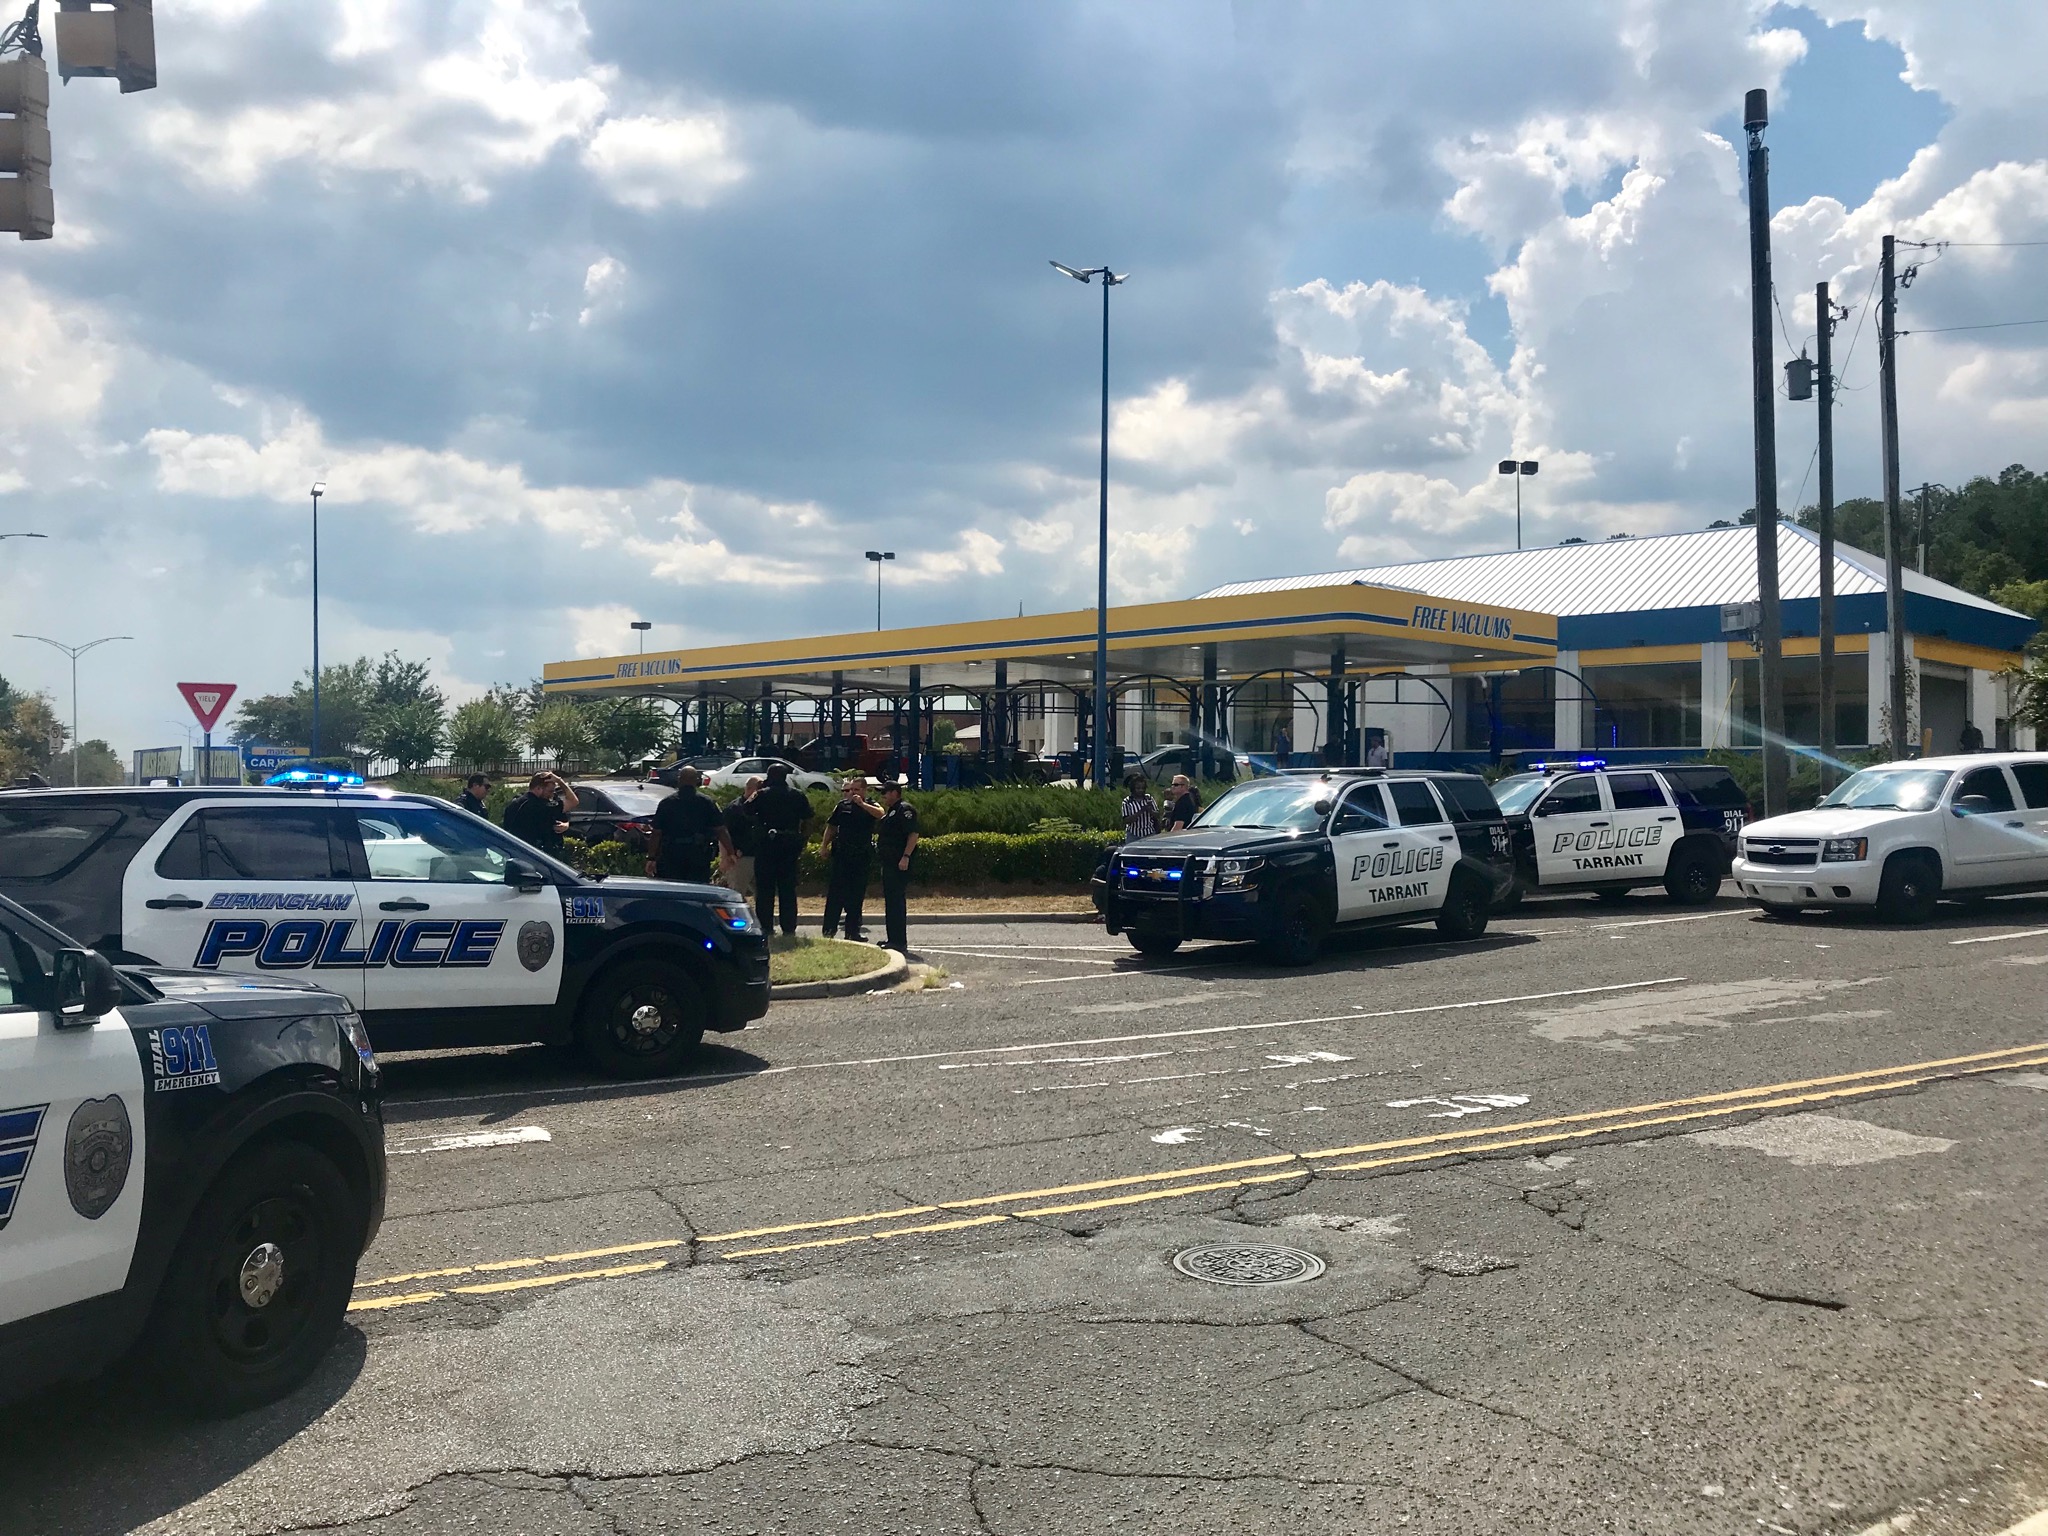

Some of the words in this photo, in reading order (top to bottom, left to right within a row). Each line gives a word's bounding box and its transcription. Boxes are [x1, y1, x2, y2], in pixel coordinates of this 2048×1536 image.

[1411, 605, 1449, 631] FREE
[1451, 610, 1512, 640] VACUUMS
[616, 662, 639, 678] FREE
[640, 658, 681, 676] VACUUMS
[198, 695, 217, 703] YIELD
[250, 758, 275, 768] CAR
[1723, 809, 1744, 818] DIAL
[1489, 826, 1506, 835] DIAL
[1725, 817, 1744, 833] 911
[1552, 826, 1663, 853] POLICE
[1351, 846, 1444, 881] POLICE
[1573, 854, 1643, 870] TARRANT
[205, 892, 355, 910] BIRMINGHAM
[1369, 882, 1429, 903] TARRANT
[565, 897, 573, 917] DIAL
[573, 896, 606, 918] 911
[193, 919, 508, 968] POLICE
[148, 1029, 165, 1077] DIAL
[161, 1024, 218, 1076] 911
[156, 1072, 218, 1091] EMERGENCY
